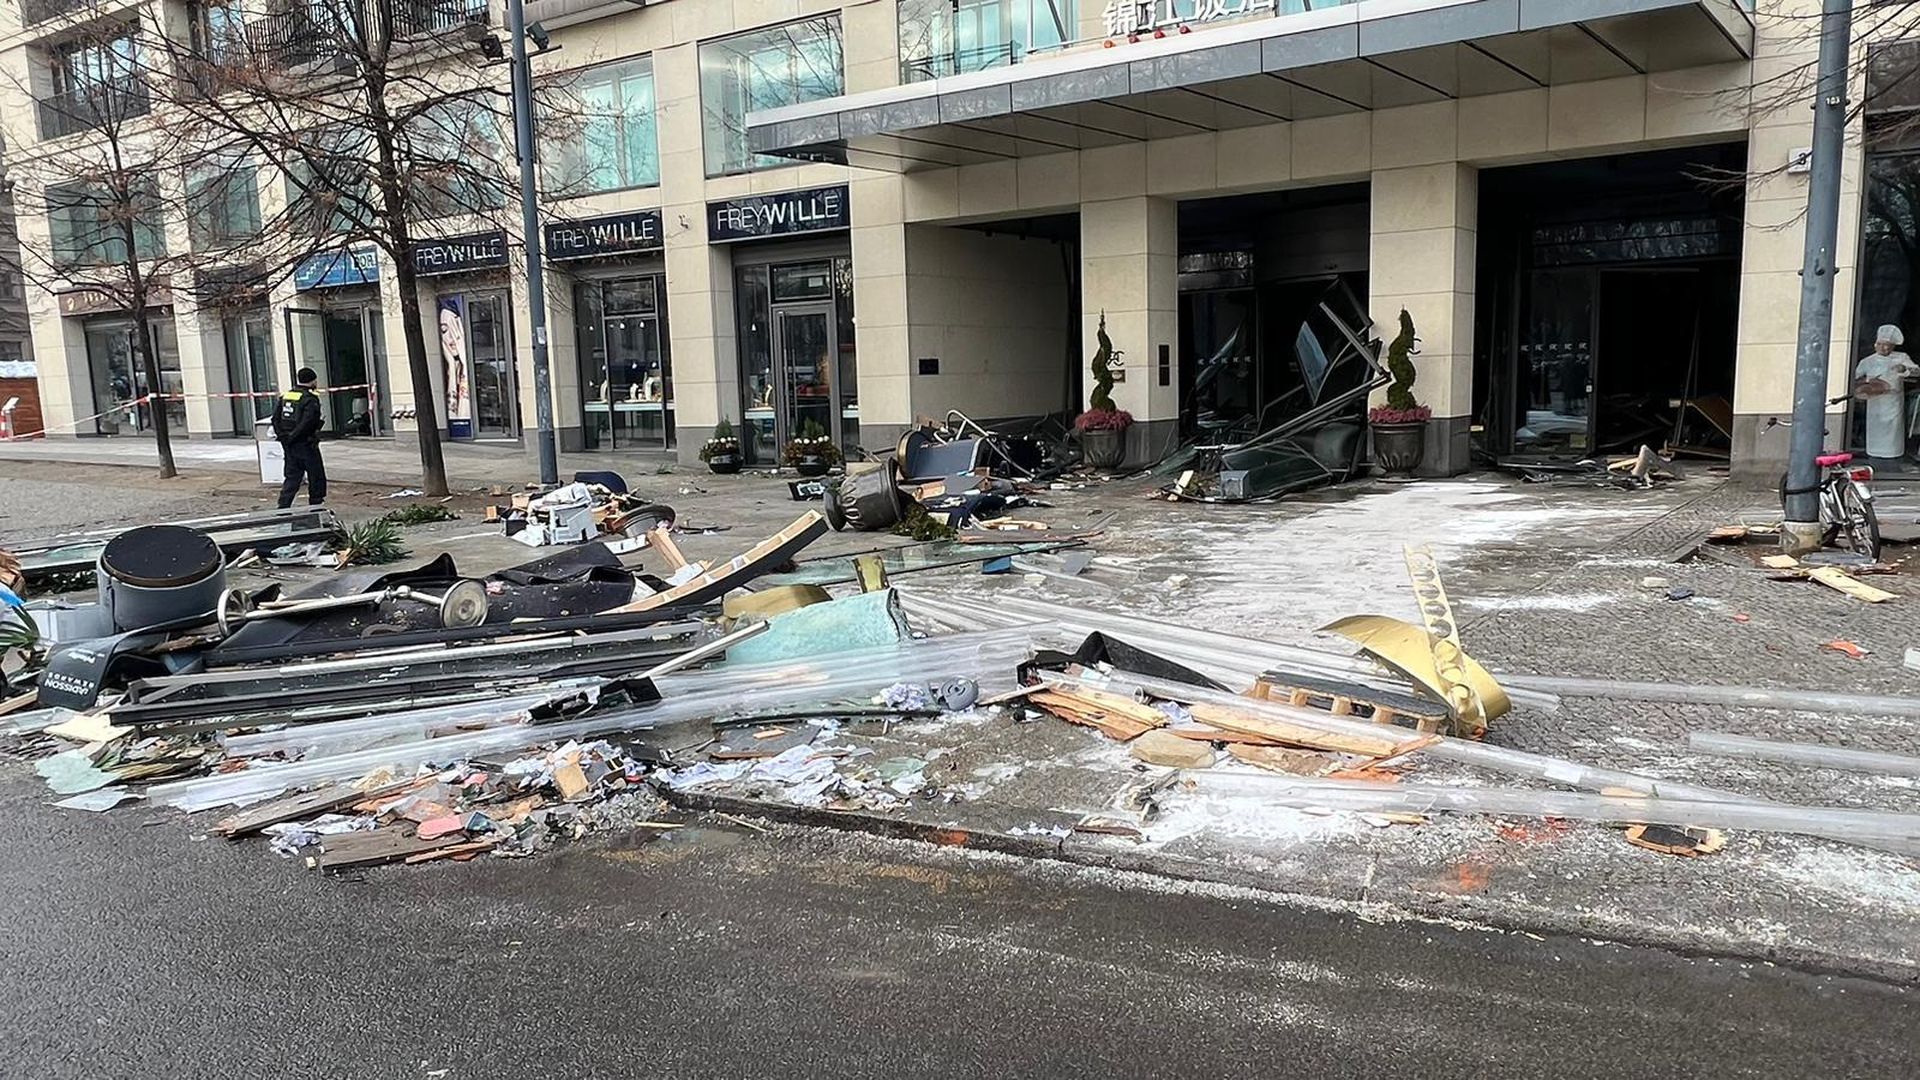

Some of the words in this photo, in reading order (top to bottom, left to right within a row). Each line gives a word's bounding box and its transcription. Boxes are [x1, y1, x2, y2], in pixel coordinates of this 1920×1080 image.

[716, 194, 840, 231] FREYWILLE
[551, 218, 655, 250] FREYWILLE
[416, 238, 502, 266] FREYWILLE
